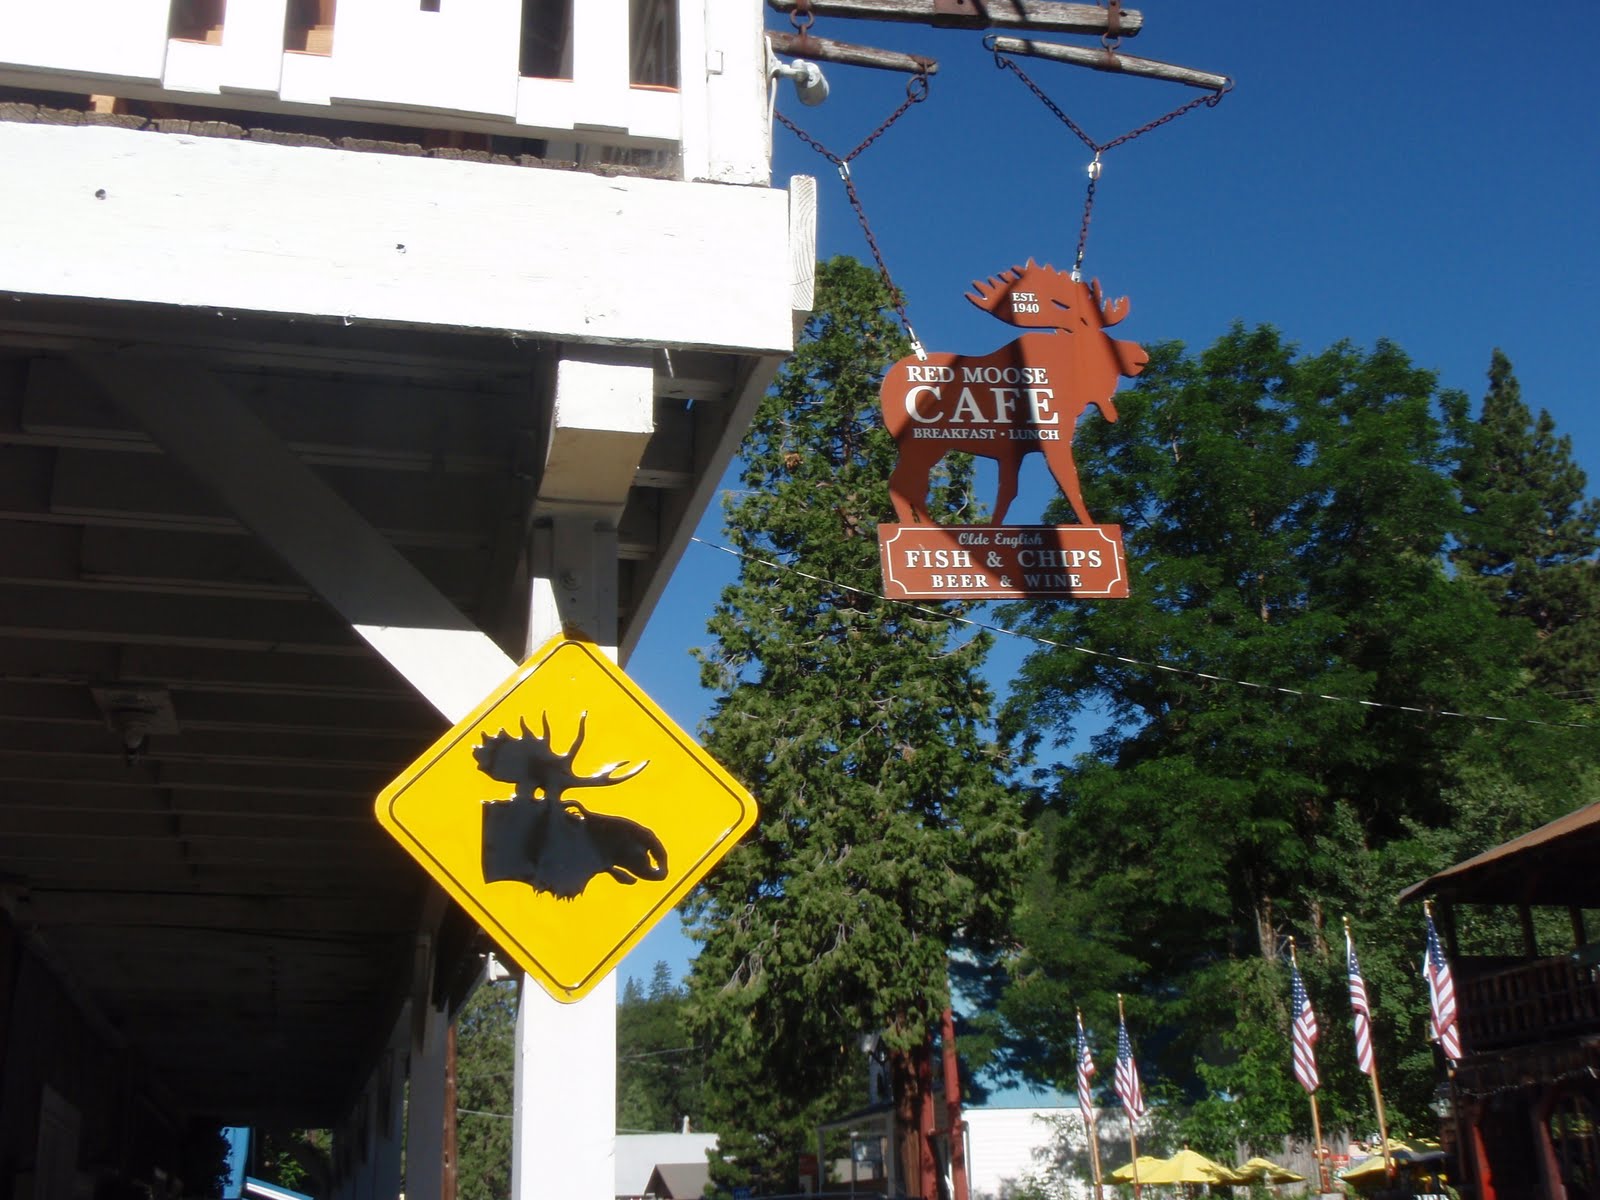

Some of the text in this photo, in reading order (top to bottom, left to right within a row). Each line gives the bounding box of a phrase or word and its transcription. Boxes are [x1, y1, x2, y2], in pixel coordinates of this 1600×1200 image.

[1012, 292, 1038, 302] EST.
[1013, 304, 1039, 313] 1940
[907, 366, 1049, 385] RED MOOSE
[905, 386, 1059, 424] CAFE
[913, 429, 1060, 440] BREAKFAST LUNCH
[958, 533, 1043, 549] Olde English
[905, 550, 1102, 568] FISH & CHIPS
[932, 575, 1082, 588] BEER & WINE
